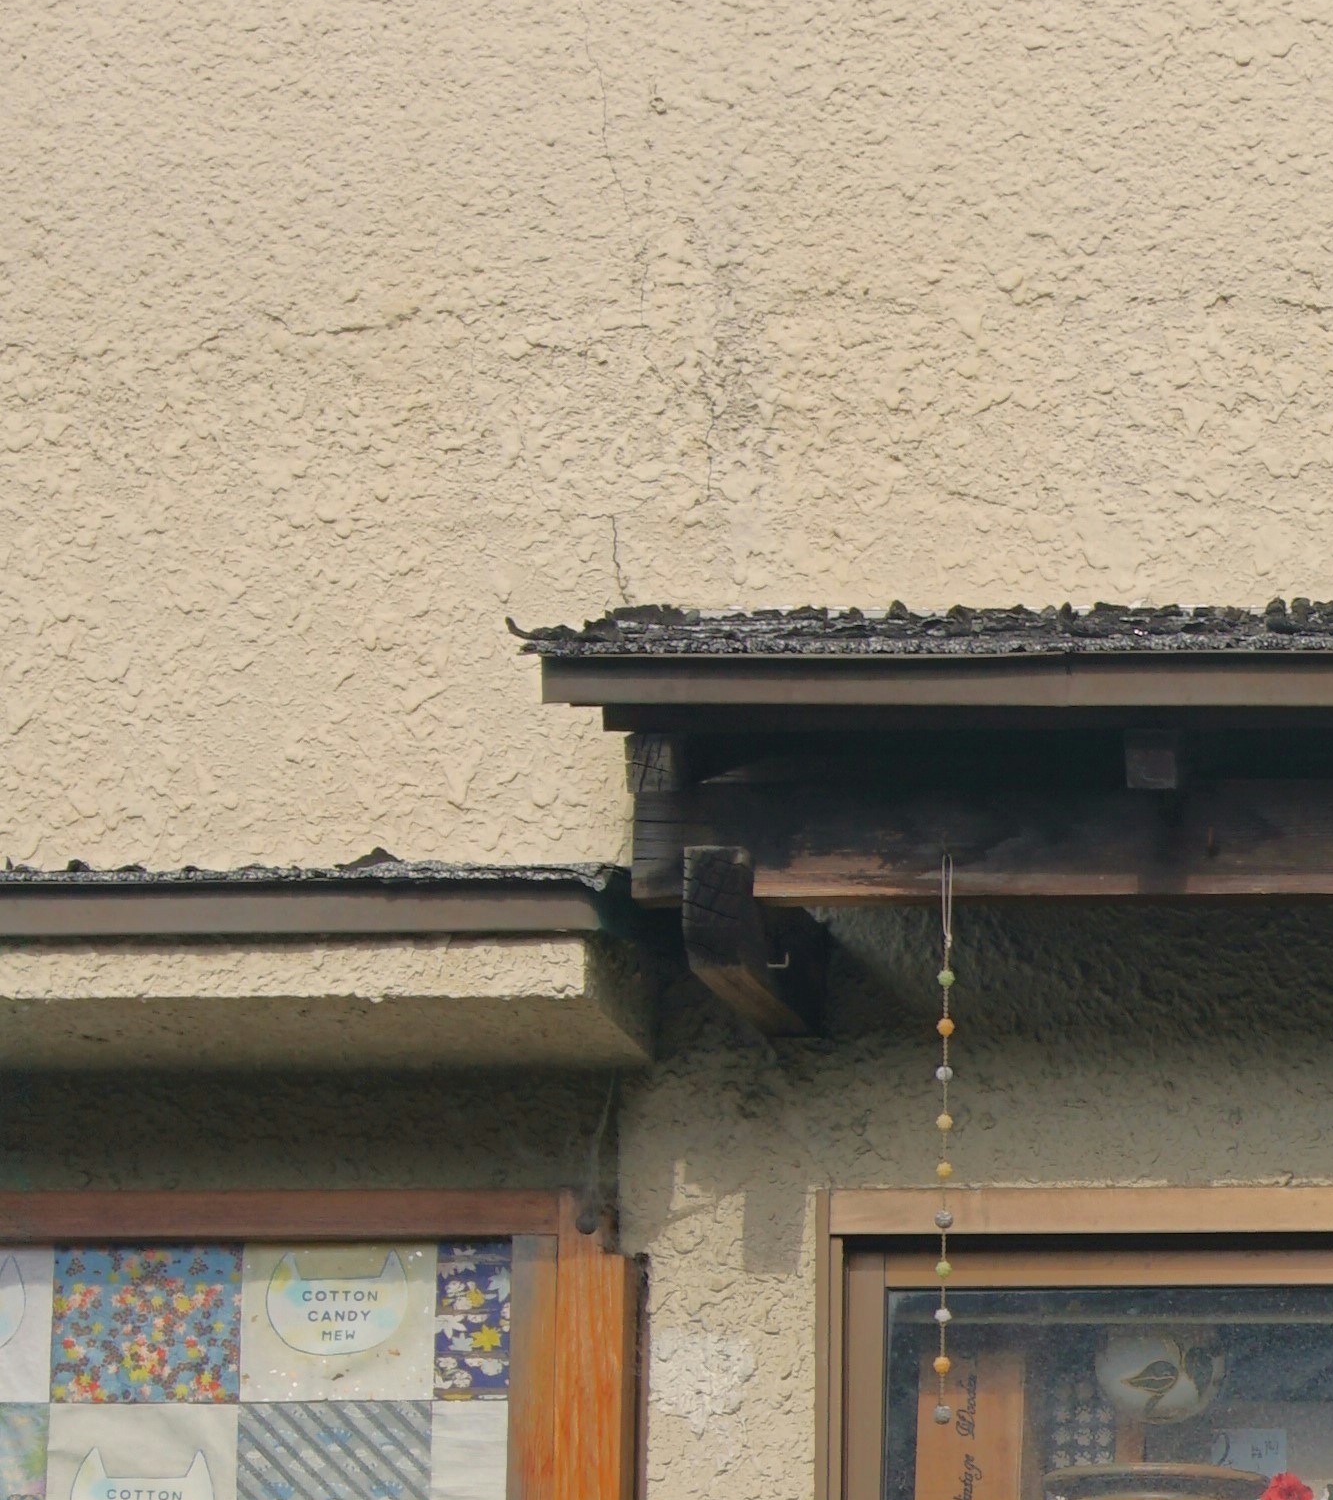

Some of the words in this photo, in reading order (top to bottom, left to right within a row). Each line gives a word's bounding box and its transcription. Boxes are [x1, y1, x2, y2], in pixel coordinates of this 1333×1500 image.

[301, 1289, 378, 1303] COTTON
[307, 1309, 371, 1323] CANDY
[321, 1330, 356, 1342] MEW
